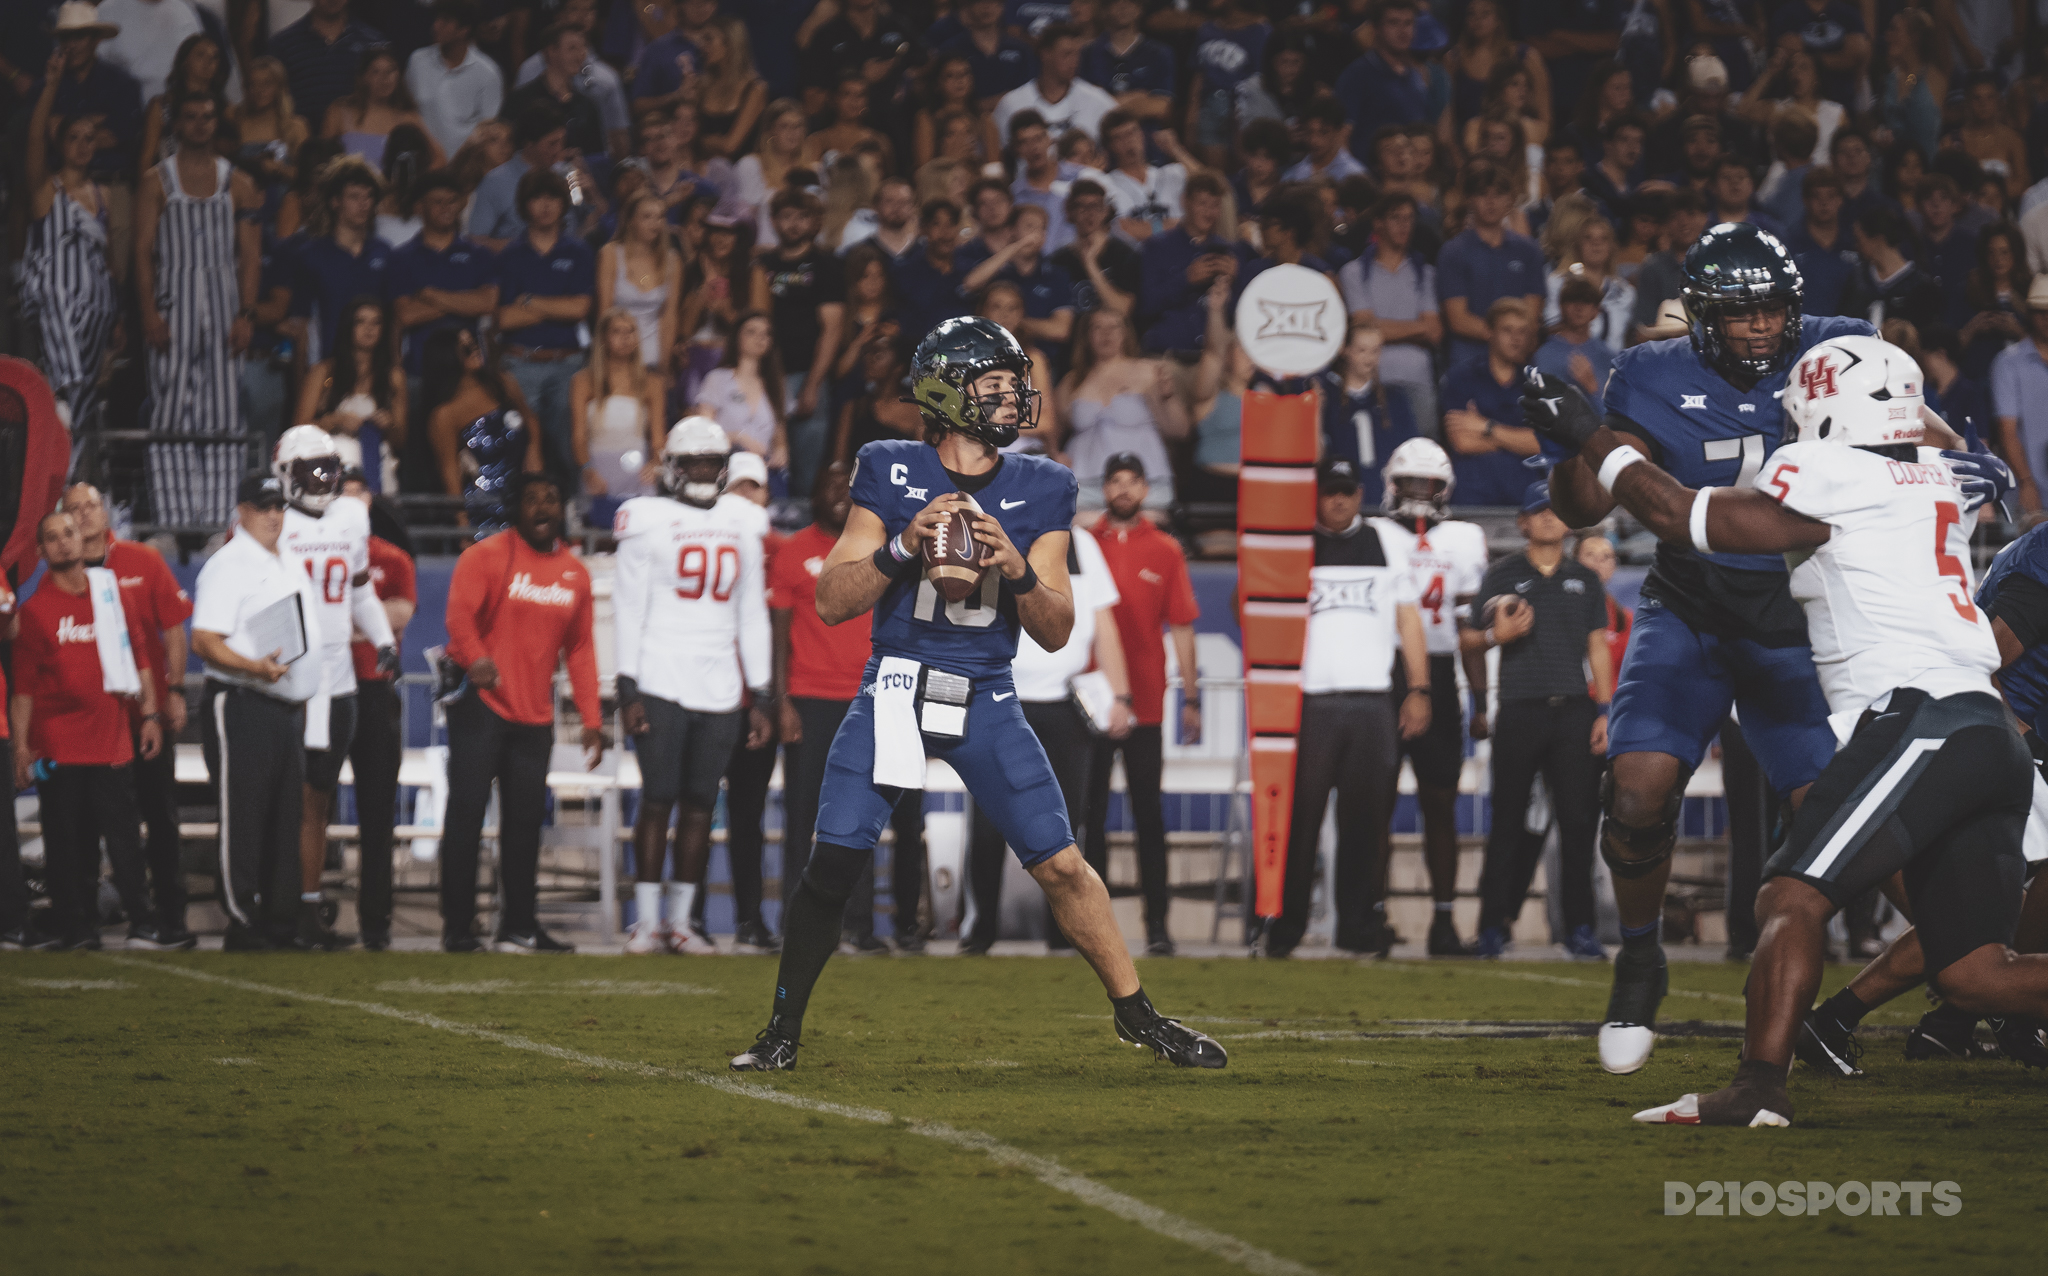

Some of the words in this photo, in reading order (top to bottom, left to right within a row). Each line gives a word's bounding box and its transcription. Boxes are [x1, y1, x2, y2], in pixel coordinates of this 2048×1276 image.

[1681, 394, 1708, 410] XII
[1738, 403, 1756, 413] TCU
[1893, 428, 1925, 440] Ridde
[1703, 434, 1765, 489] 7
[890, 463, 908, 486] C
[1770, 464, 1800, 503] 5
[904, 485, 929, 502] XII
[1934, 501, 1979, 625] 5
[674, 545, 741, 603] 90
[882, 673, 914, 690] TCU
